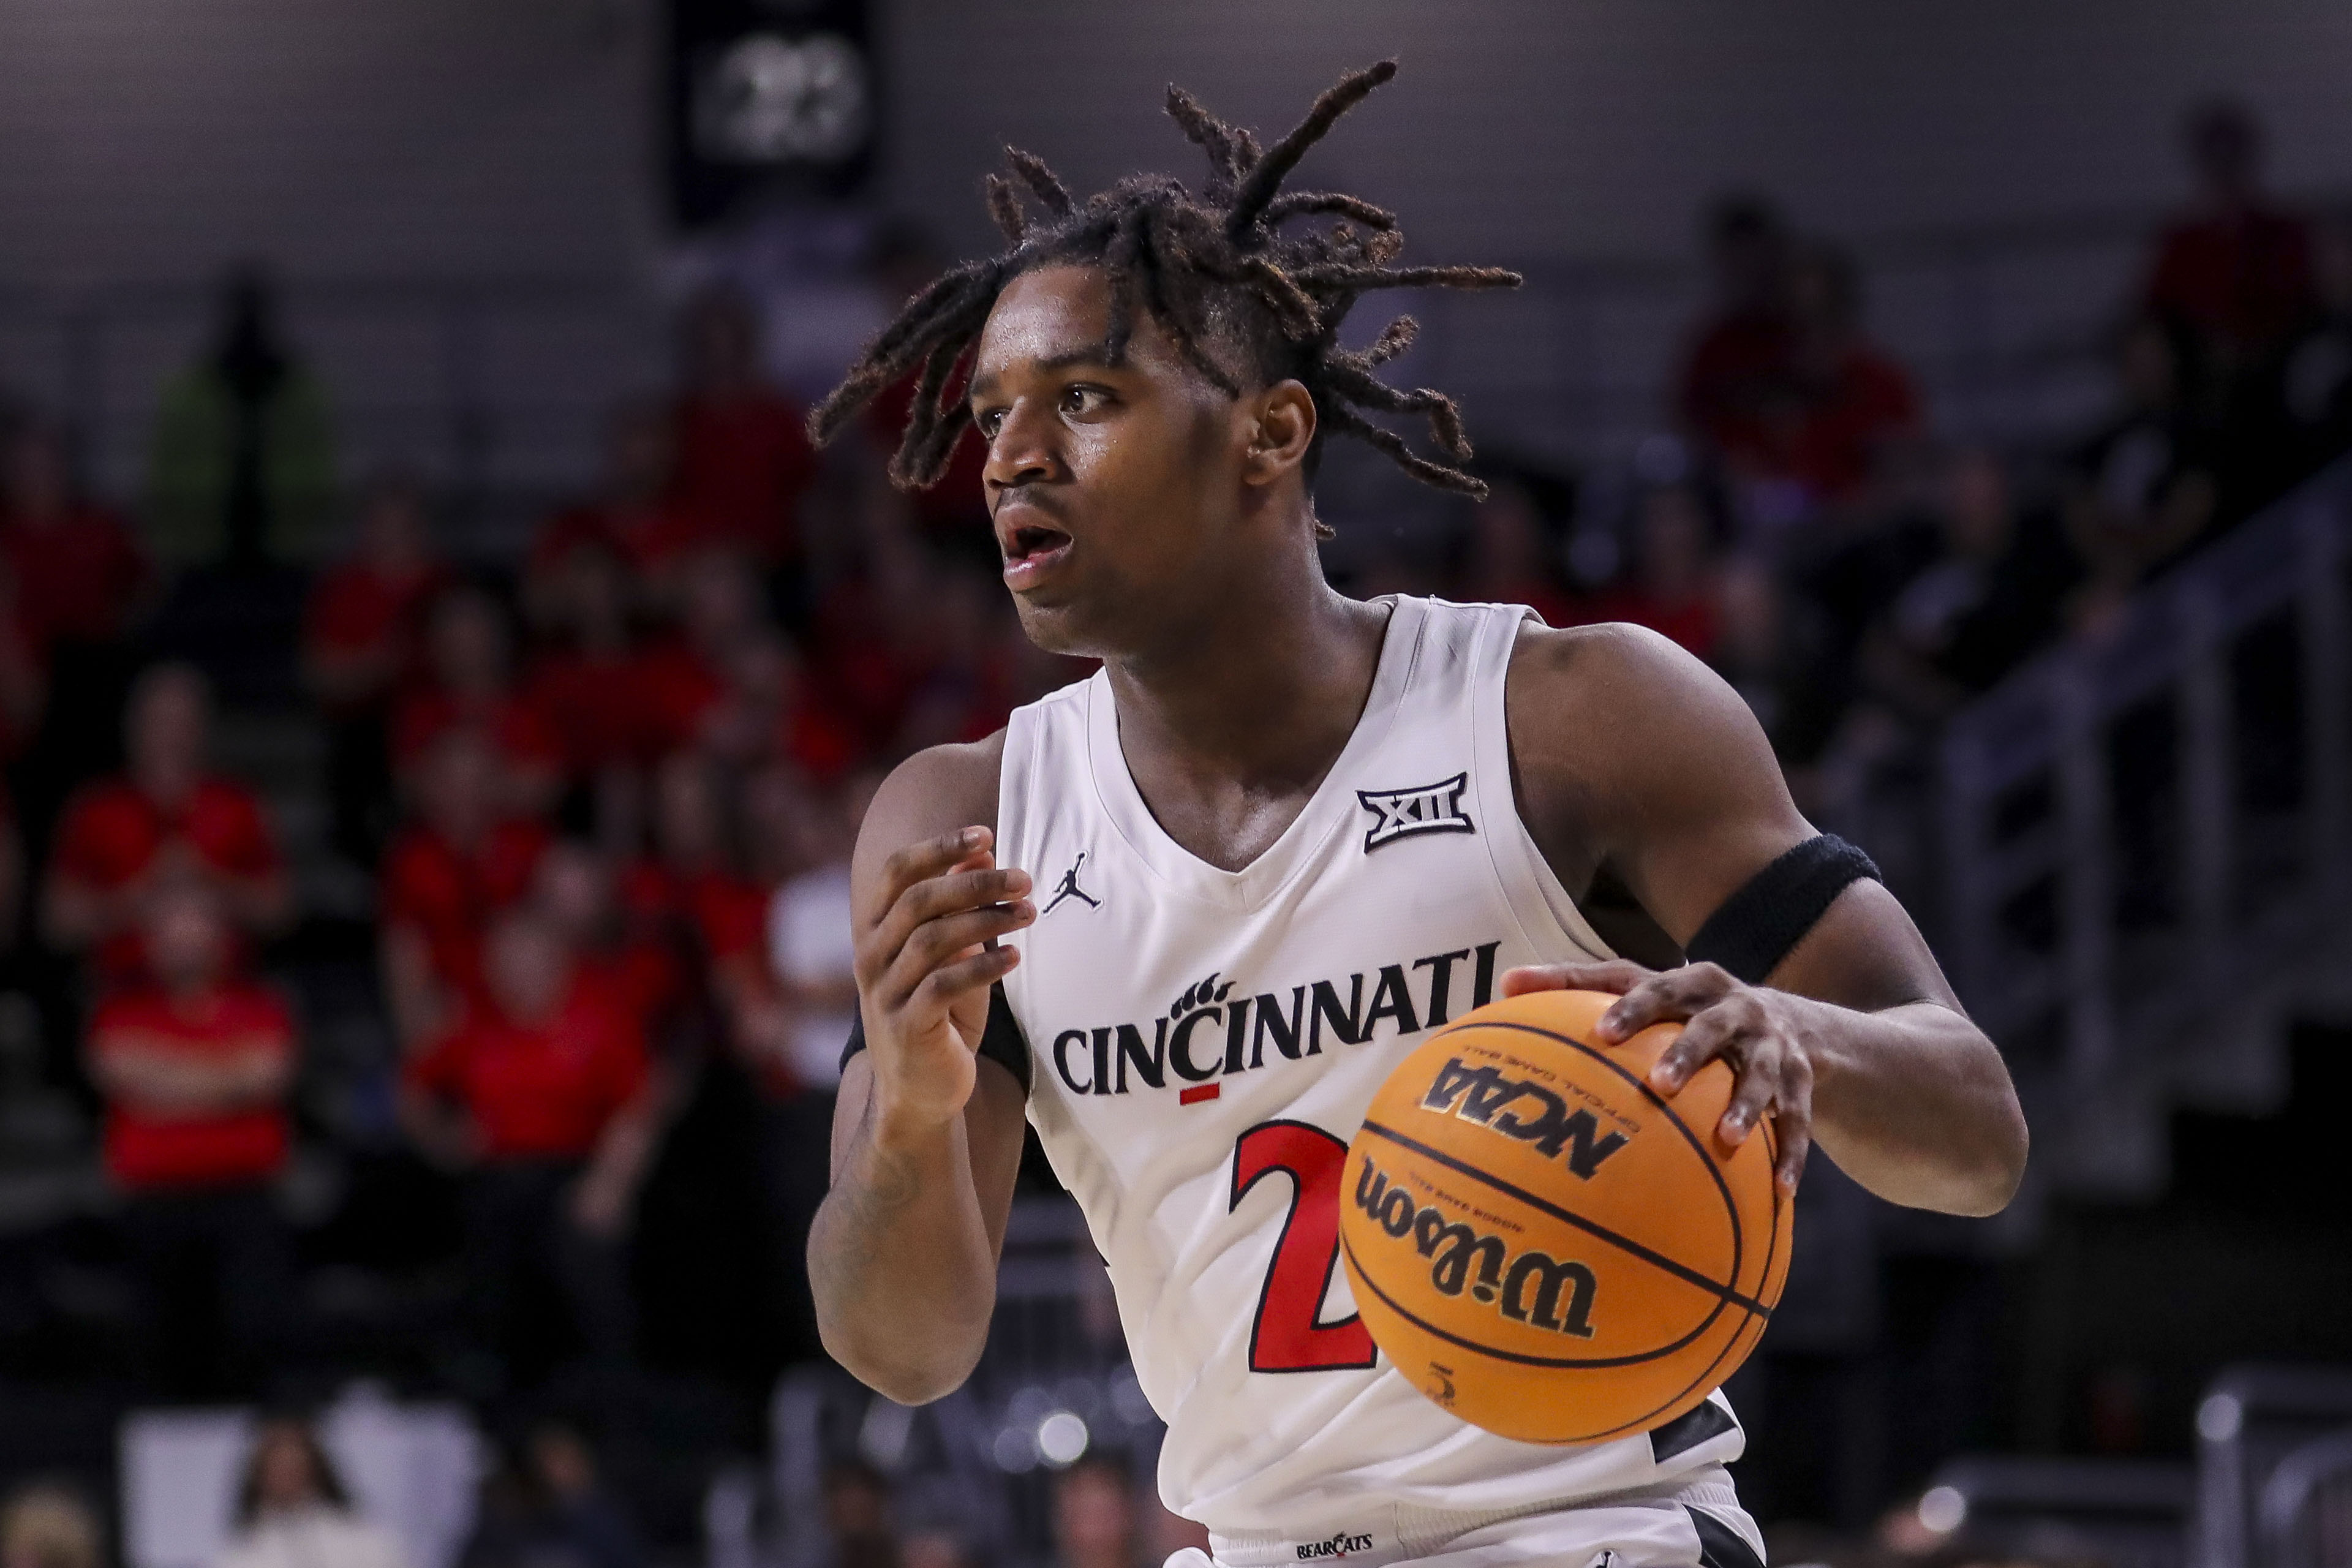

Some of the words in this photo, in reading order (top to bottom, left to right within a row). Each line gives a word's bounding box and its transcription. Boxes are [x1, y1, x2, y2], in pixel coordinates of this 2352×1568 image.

[1354, 771, 1476, 854] XII
[1053, 941, 1502, 1095] CINCINNATI
[1420, 1057, 1630, 1181] NCAA
[1229, 1119, 1378, 1373] 2
[1355, 1152, 1596, 1340] Wilson
[1296, 1531, 1372, 1559] BEARCATS
